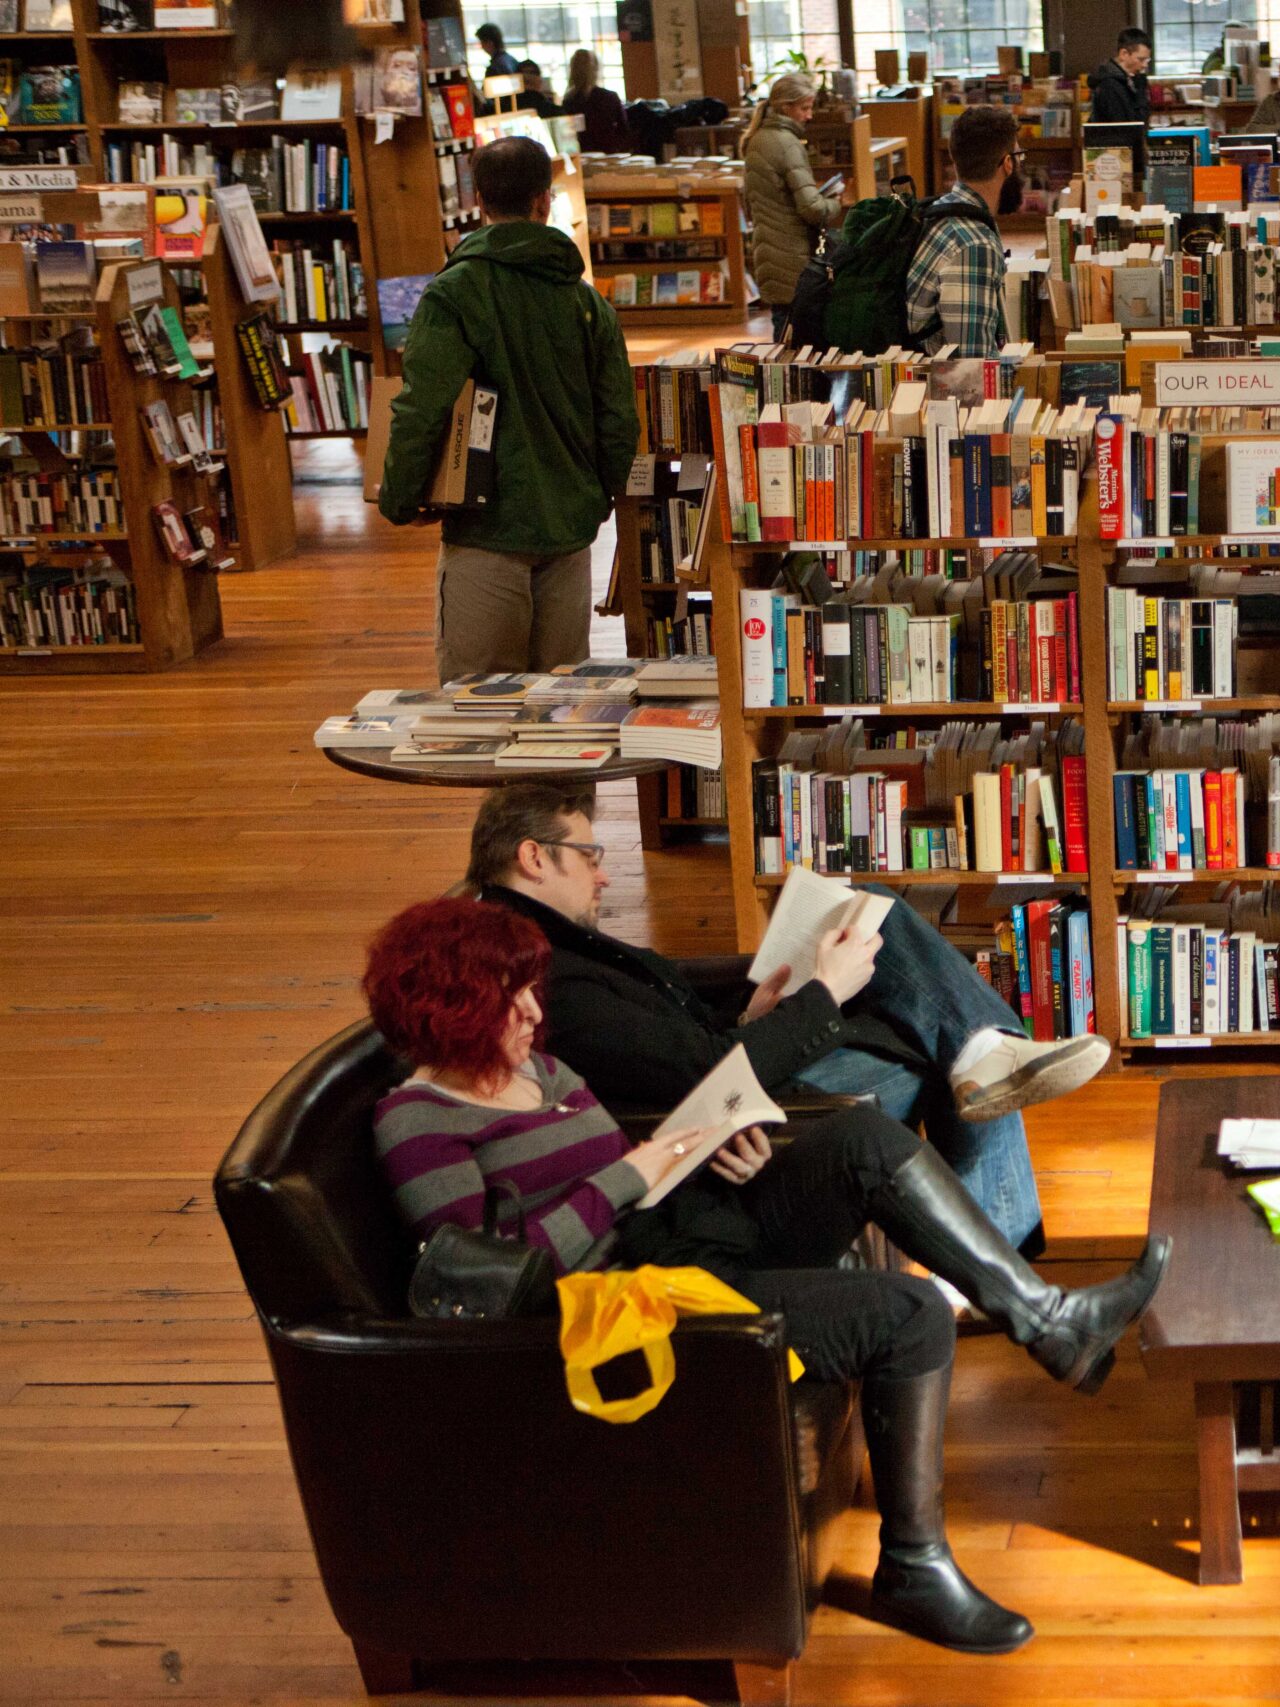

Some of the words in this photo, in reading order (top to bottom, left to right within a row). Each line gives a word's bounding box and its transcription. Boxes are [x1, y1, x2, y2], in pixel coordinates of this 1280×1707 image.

[9, 175, 21, 187] &
[26, 174, 73, 187] Media
[0, 206, 36, 217] ama
[1164, 375, 1209, 391] OUR
[1218, 374, 1274, 390] IDEAL
[903, 438, 911, 477] BEOWULF
[1097, 440, 1112, 510] Webster's
[1110, 469, 1118, 503] Merriam-
[1139, 812, 1147, 837] ACTION
[1052, 966, 1061, 982] TREK
[1133, 946, 1143, 993] Geographical
[1193, 957, 1202, 970] Cold
[1073, 959, 1082, 1000] PEANUTS
[1193, 970, 1202, 999] Mountain
[1135, 994, 1144, 1034] Dictionary
